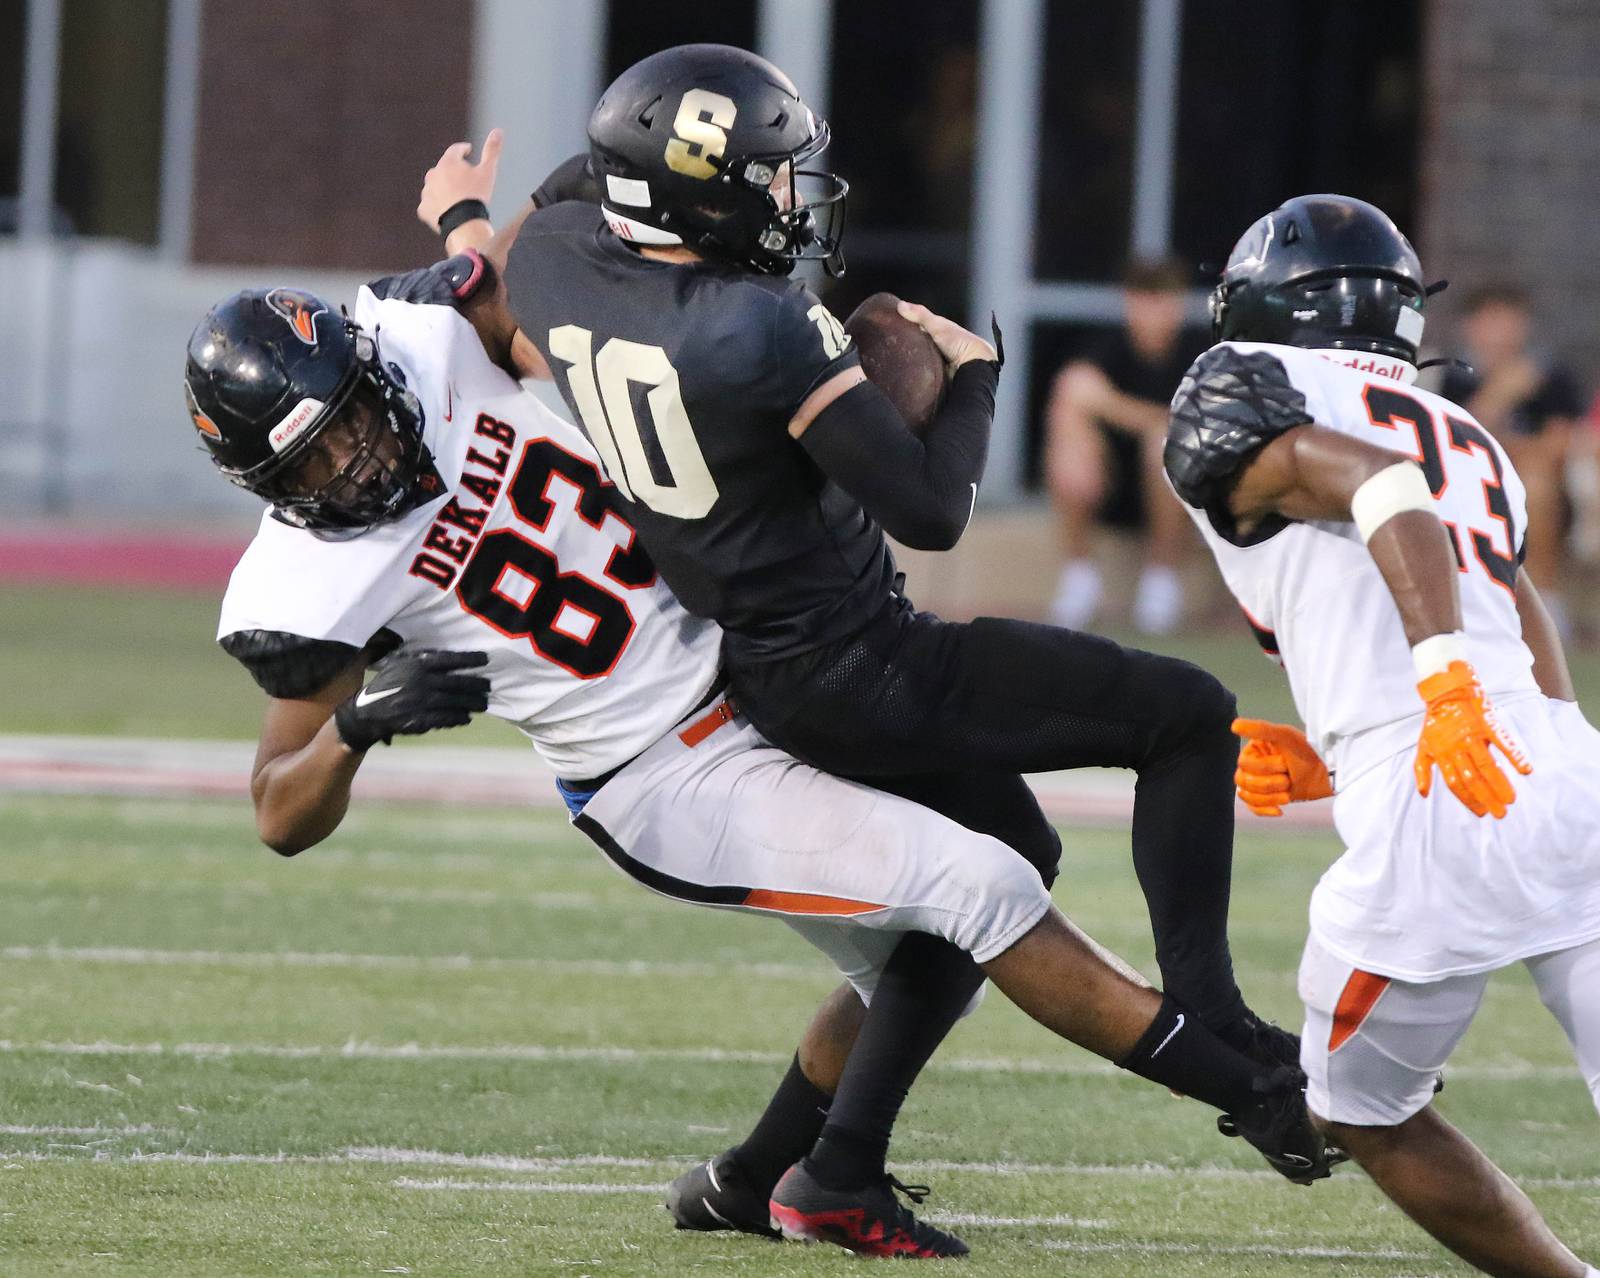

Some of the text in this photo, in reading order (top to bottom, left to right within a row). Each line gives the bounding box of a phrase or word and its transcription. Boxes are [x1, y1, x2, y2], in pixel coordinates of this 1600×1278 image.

[409, 412, 517, 592] DEKALB
[548, 324, 720, 519] 10
[455, 436, 658, 680] 83
